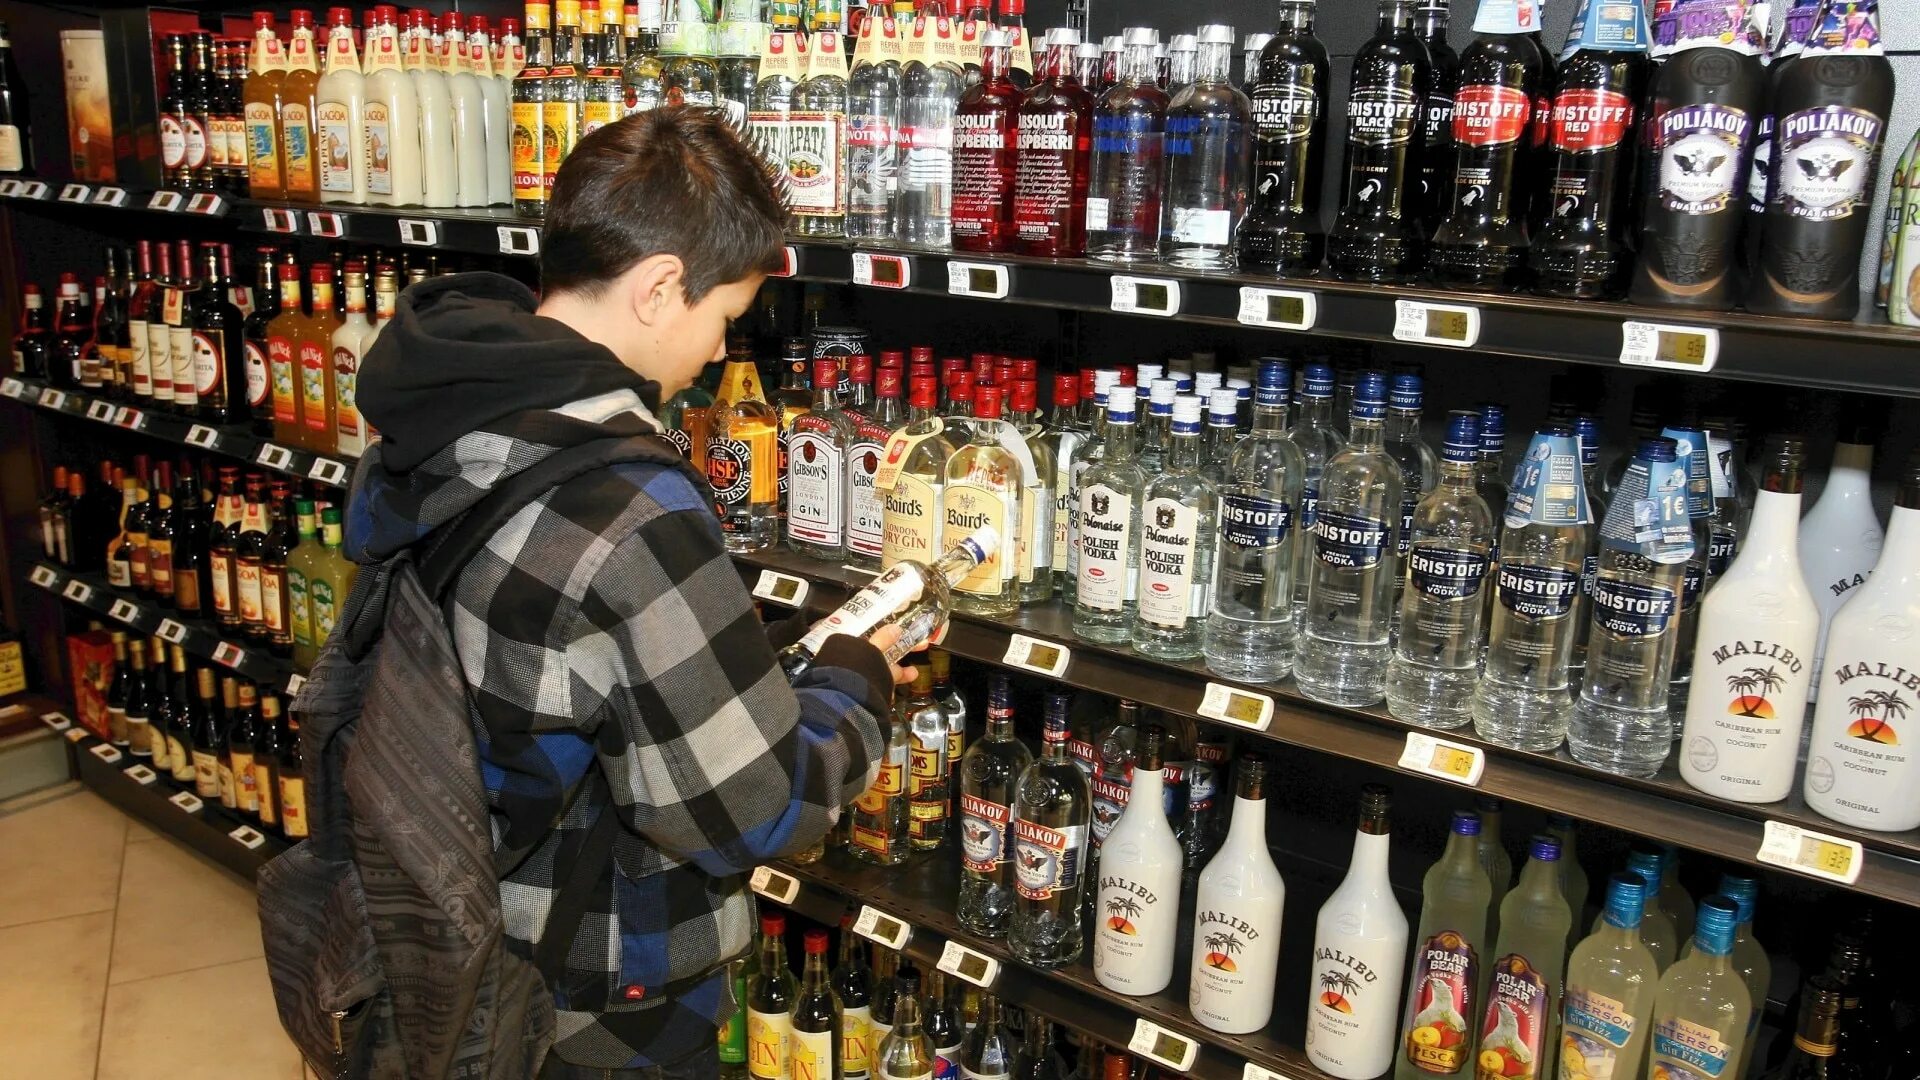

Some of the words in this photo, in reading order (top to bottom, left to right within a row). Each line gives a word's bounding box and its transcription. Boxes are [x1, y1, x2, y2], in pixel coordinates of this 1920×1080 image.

[320, 109, 346, 121] LAGOA
[1256, 112, 1292, 124] BLACK
[1355, 116, 1394, 128] BLACK
[1466, 117, 1492, 128] RED
[1663, 110, 1748, 136] POLIAKOV
[1564, 121, 1591, 133] RED
[1785, 112, 1877, 139] POLIAKOV
[707, 460, 738, 479] HSE
[794, 459, 827, 481] GIBSON'S
[795, 491, 825, 502] LONDON
[799, 504, 821, 517] GIN
[855, 503, 880, 514] LONDO
[885, 493, 924, 518] Baird's
[859, 516, 882, 531] GIN
[886, 522, 919, 537] LONDON
[1082, 510, 1125, 533] Polonaise
[902, 536, 927, 550] GIN
[1082, 533, 1120, 551] POLISH
[1144, 524, 1191, 547] Polonaise
[1228, 534, 1261, 548] VODKA
[1083, 545, 1118, 561] VODKA
[1144, 547, 1186, 565] POLISH
[1321, 553, 1356, 568] VODKA
[1145, 560, 1184, 576] VODKA
[1411, 553, 1484, 578] ERISTOFF
[1426, 586, 1462, 598] VODKA
[1500, 570, 1577, 597] ERISTOFF
[1593, 586, 1672, 615] ERISTOFF
[1515, 603, 1552, 617] VODKA
[1604, 620, 1643, 635] VODKA
[1712, 639, 1803, 674] MALIBU
[1833, 661, 1920, 708] MALIB
[1714, 720, 1764, 735] CARIBBEAN
[1725, 738, 1768, 750] COCONUT
[1833, 741, 1884, 760] CARIBBEAN
[1843, 761, 1888, 777] COCONUT
[1720, 774, 1763, 787] ORIGINAL
[962, 797, 1004, 821] LIAKOV
[1835, 798, 1881, 815] ORIGINAL
[1099, 875, 1158, 906] MALIBU
[1198, 909, 1260, 942] MALIBU
[1106, 945, 1133, 958] COCONUT
[1427, 949, 1470, 969] POLAR
[1315, 946, 1378, 985] MALIBU
[1430, 960, 1465, 978] BEAR
[1104, 971, 1132, 984] ORIGINAL
[1496, 972, 1538, 996] POLAR
[1204, 982, 1233, 996] COCONUT
[1497, 982, 1531, 1005] BEAR
[1200, 1009, 1230, 1023] ORIGINAL
[1317, 1022, 1347, 1039] COCONUT
[1413, 1045, 1457, 1064] PESCA
[1668, 1039, 1704, 1057] COCKTAIL
[1314, 1049, 1344, 1067] ORIGINAL
